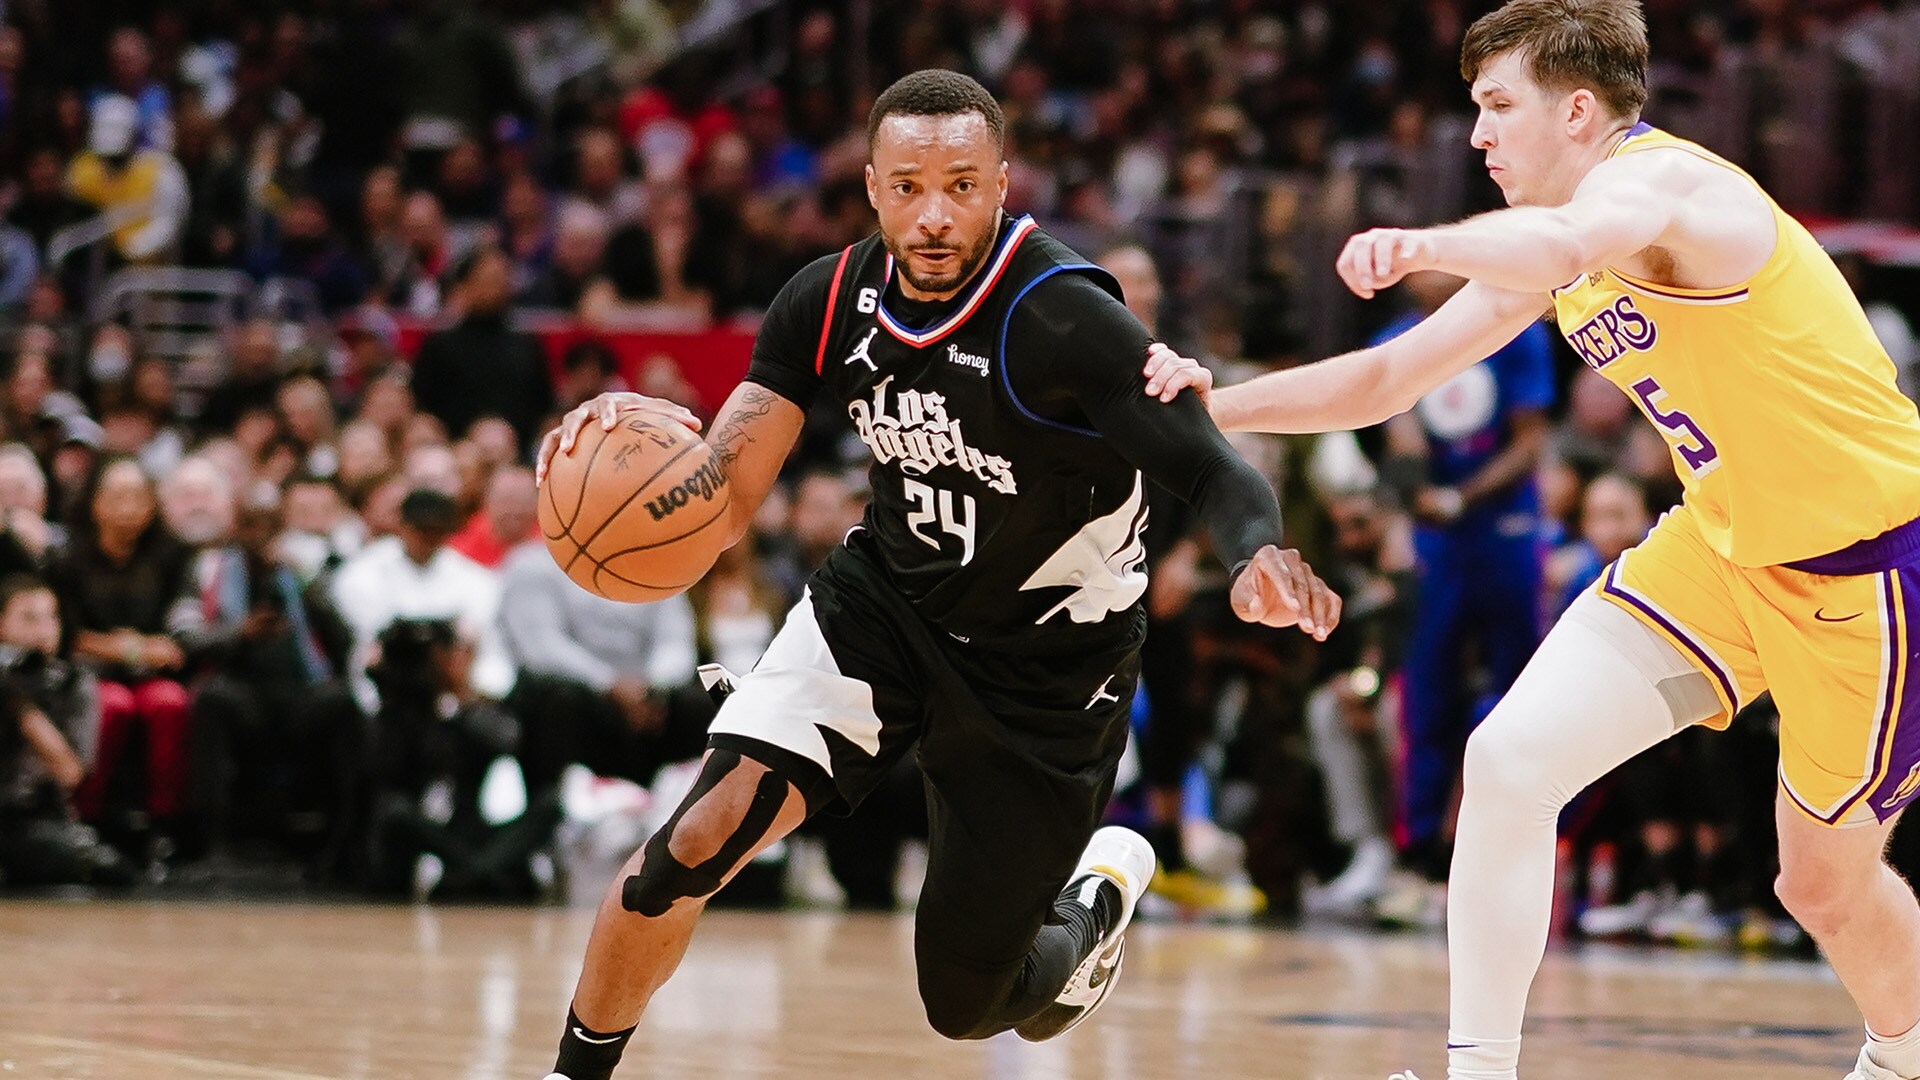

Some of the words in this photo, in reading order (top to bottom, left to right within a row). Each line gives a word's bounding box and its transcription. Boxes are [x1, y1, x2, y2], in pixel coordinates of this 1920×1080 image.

[857, 287, 878, 314] 6
[1566, 295, 1657, 370] KERS
[947, 343, 990, 377] honey
[872, 374, 950, 433] Los
[848, 399, 1017, 494] Angeles
[903, 477, 977, 567] 24
